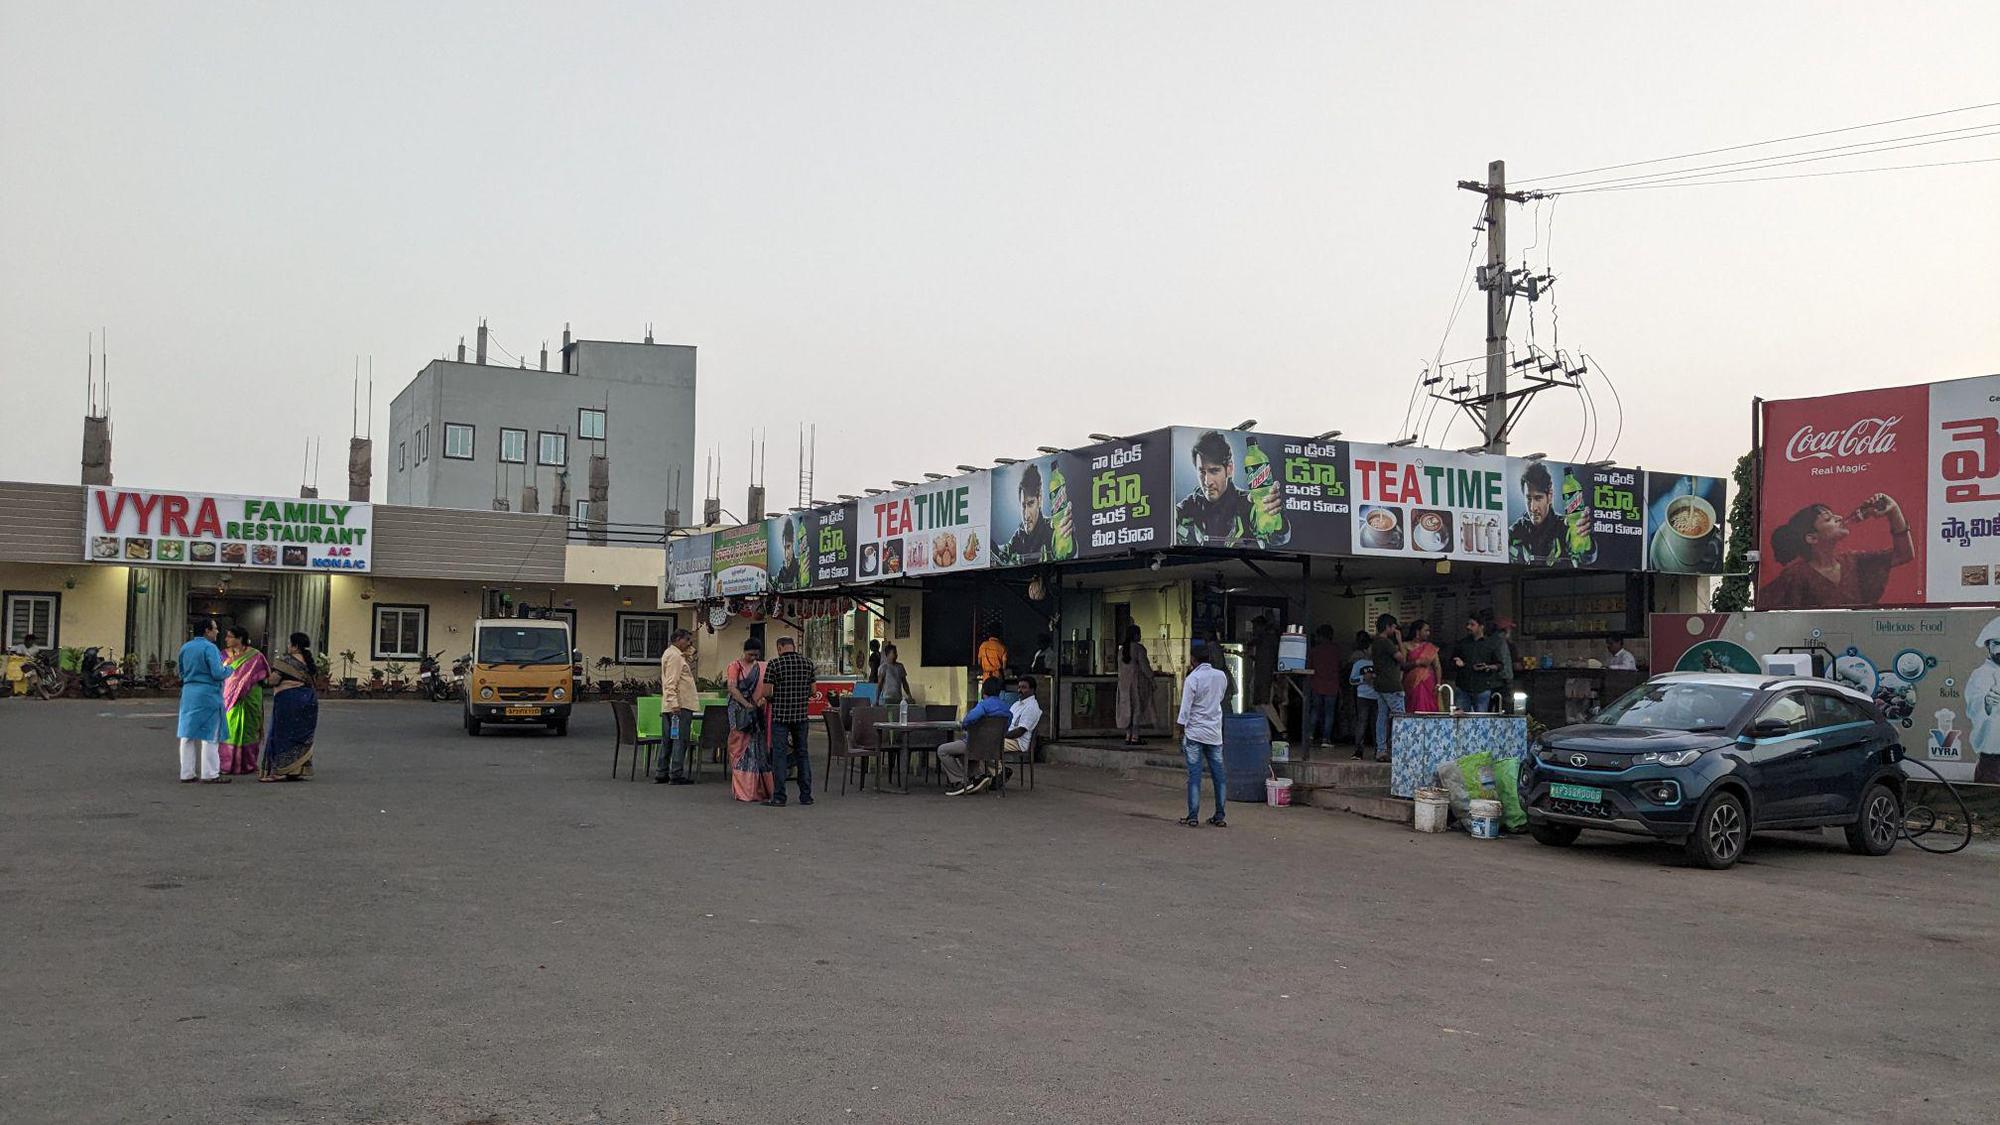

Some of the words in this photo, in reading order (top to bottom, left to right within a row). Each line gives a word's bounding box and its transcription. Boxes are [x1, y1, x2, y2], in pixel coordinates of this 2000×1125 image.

[1786, 415, 1904, 462] Coca-Cola
[1811, 467, 1834, 476] Real
[1836, 464, 1868, 474] Magic
[95, 490, 223, 538] VYRA
[244, 500, 351, 525] FAMILY
[227, 522, 367, 546] RESTAURANT
[328, 546, 352, 557] A/C
[1876, 620, 1915, 632] Delicious
[1920, 620, 1943, 632] Food
[1931, 747, 1959, 756] VYRA
